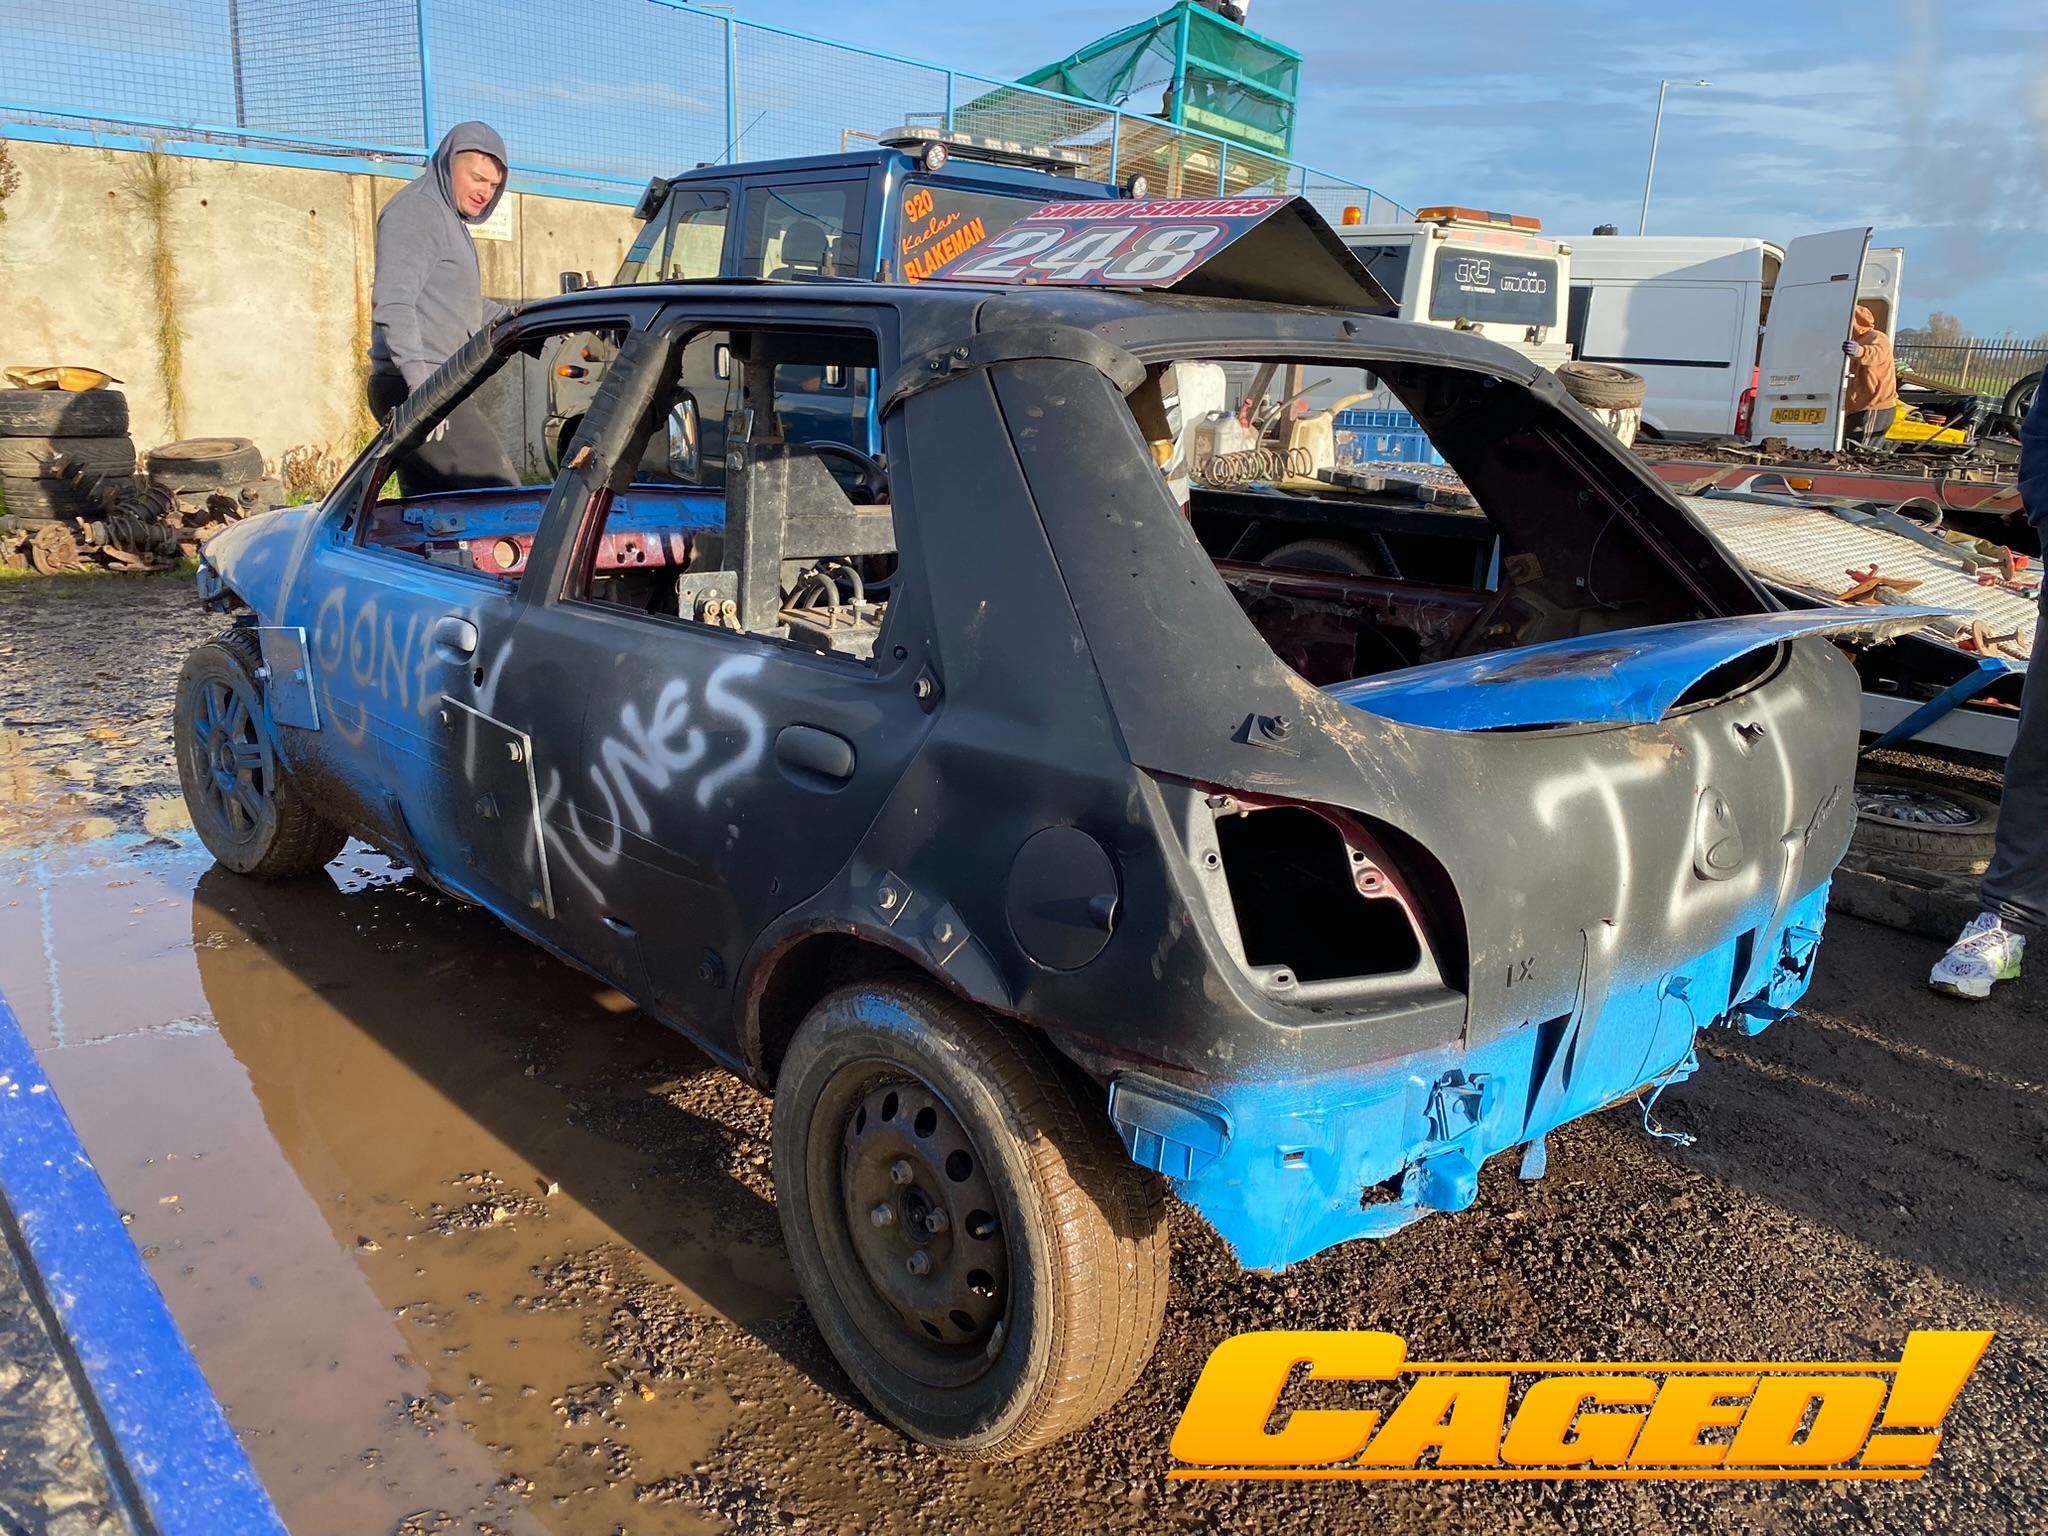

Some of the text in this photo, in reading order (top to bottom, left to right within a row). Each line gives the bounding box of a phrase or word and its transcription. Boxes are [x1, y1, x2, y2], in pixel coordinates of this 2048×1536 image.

[904, 189, 934, 223] 920
[1027, 197, 1284, 221] SANTRY SERVICES
[901, 212, 961, 255] Kaelan
[904, 217, 986, 285] BLAKEMAN
[951, 224, 1221, 281] 248
[1775, 409, 1822, 421] NG08 YFX
